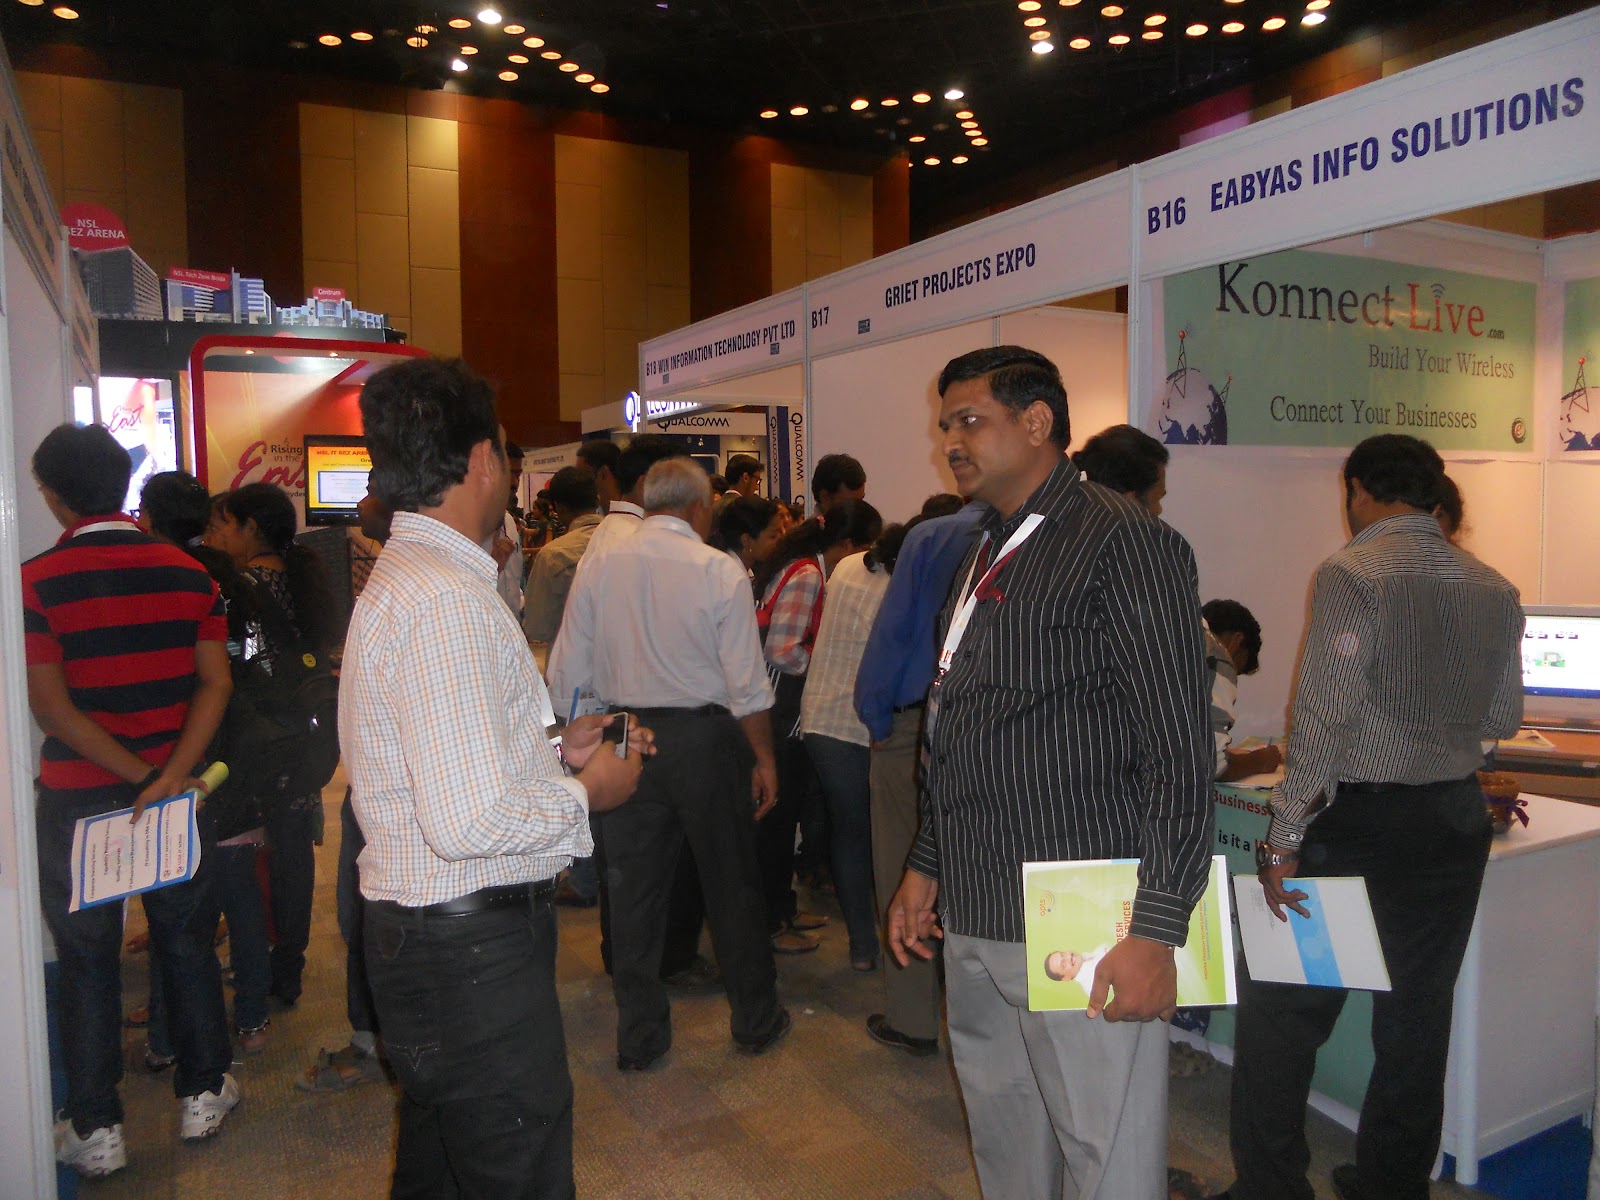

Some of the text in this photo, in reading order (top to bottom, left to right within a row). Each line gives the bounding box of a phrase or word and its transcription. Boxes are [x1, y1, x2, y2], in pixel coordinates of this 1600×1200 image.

[1147, 77, 1585, 234] B16 EABYAS INFO SOLUTIONS
[77, 219, 99, 229] NSL
[86, 228, 126, 239] ARENA
[318, 288, 342, 296] Centrum
[811, 306, 830, 329] B17
[885, 279, 919, 308] GRIET
[923, 256, 991, 298] PROJECTS
[996, 242, 1036, 277] EXPO
[1216, 261, 1394, 327] Konnect
[1408, 283, 1486, 338] Live
[646, 361, 657, 376] B18
[657, 358, 670, 374] WIN
[670, 345, 713, 371] INFORMATION
[714, 330, 760, 357] TECHNOLOGY
[763, 325, 779, 345] PVT
[781, 320, 796, 340] LTD
[1368, 344, 1514, 379] Build Your Wireless
[1270, 395, 1477, 429] Connect Your Businesses
[271, 444, 303, 455] Rising
[285, 454, 300, 462] the
[789, 412, 805, 481] QUALCOMM
[230, 441, 305, 491] Eas
[1218, 830, 1228, 845] is
[1231, 834, 1241, 849] it
[1243, 841, 1251, 852] a
[1116, 922, 1124, 943] DESH
